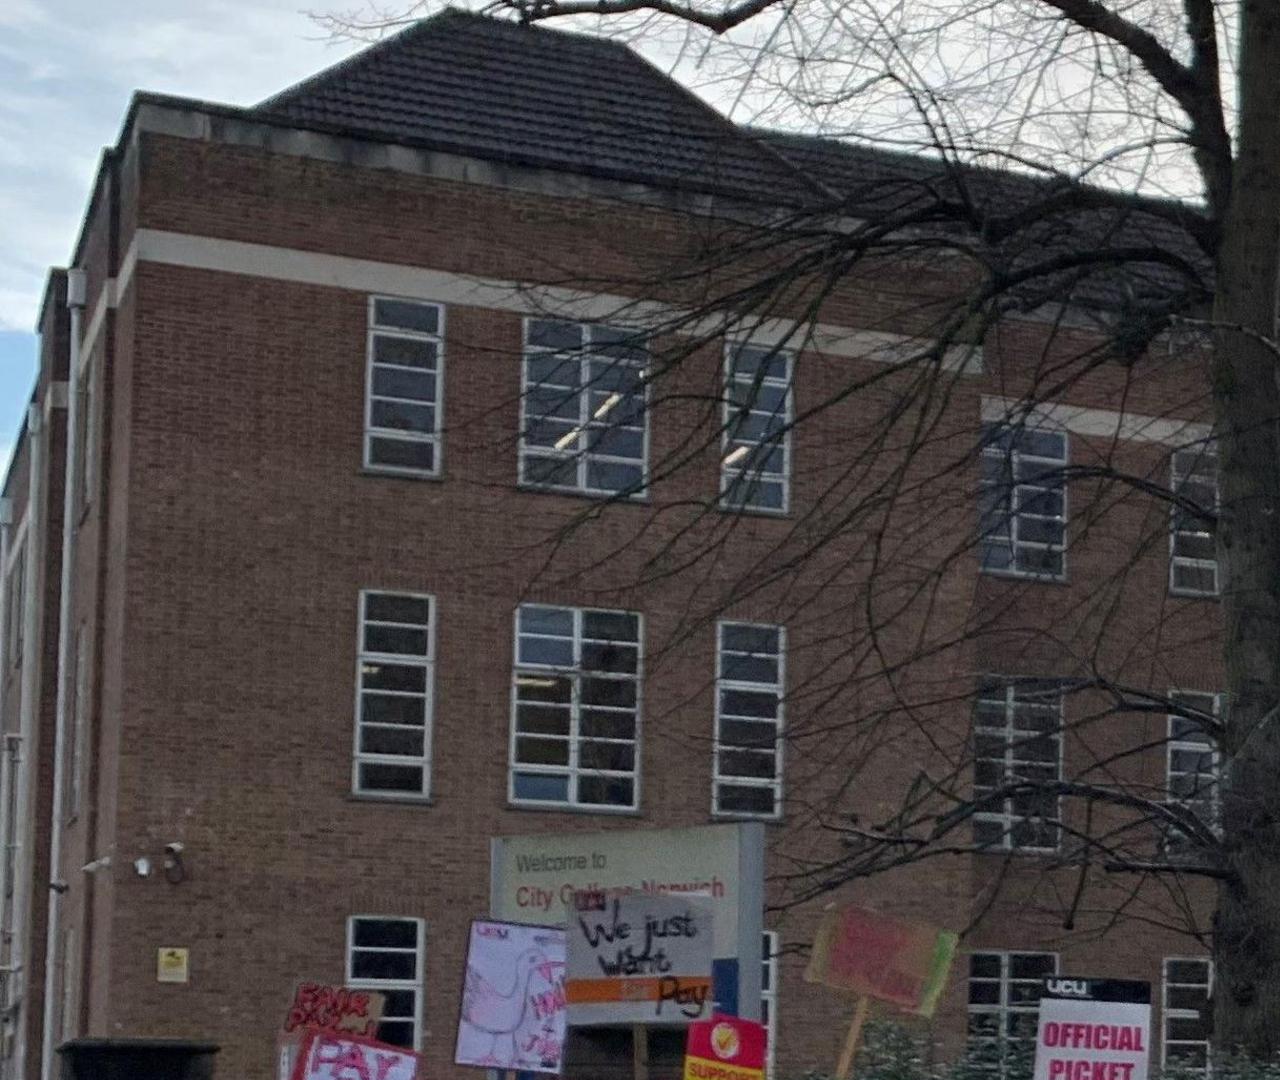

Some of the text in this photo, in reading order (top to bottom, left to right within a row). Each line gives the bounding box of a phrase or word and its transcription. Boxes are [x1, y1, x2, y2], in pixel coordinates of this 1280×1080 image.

[517, 852, 607, 873] Welcome to
[516, 885, 553, 910] City
[579, 899, 697, 958] We just
[1044, 1021, 1144, 1052] OFFICIAL
